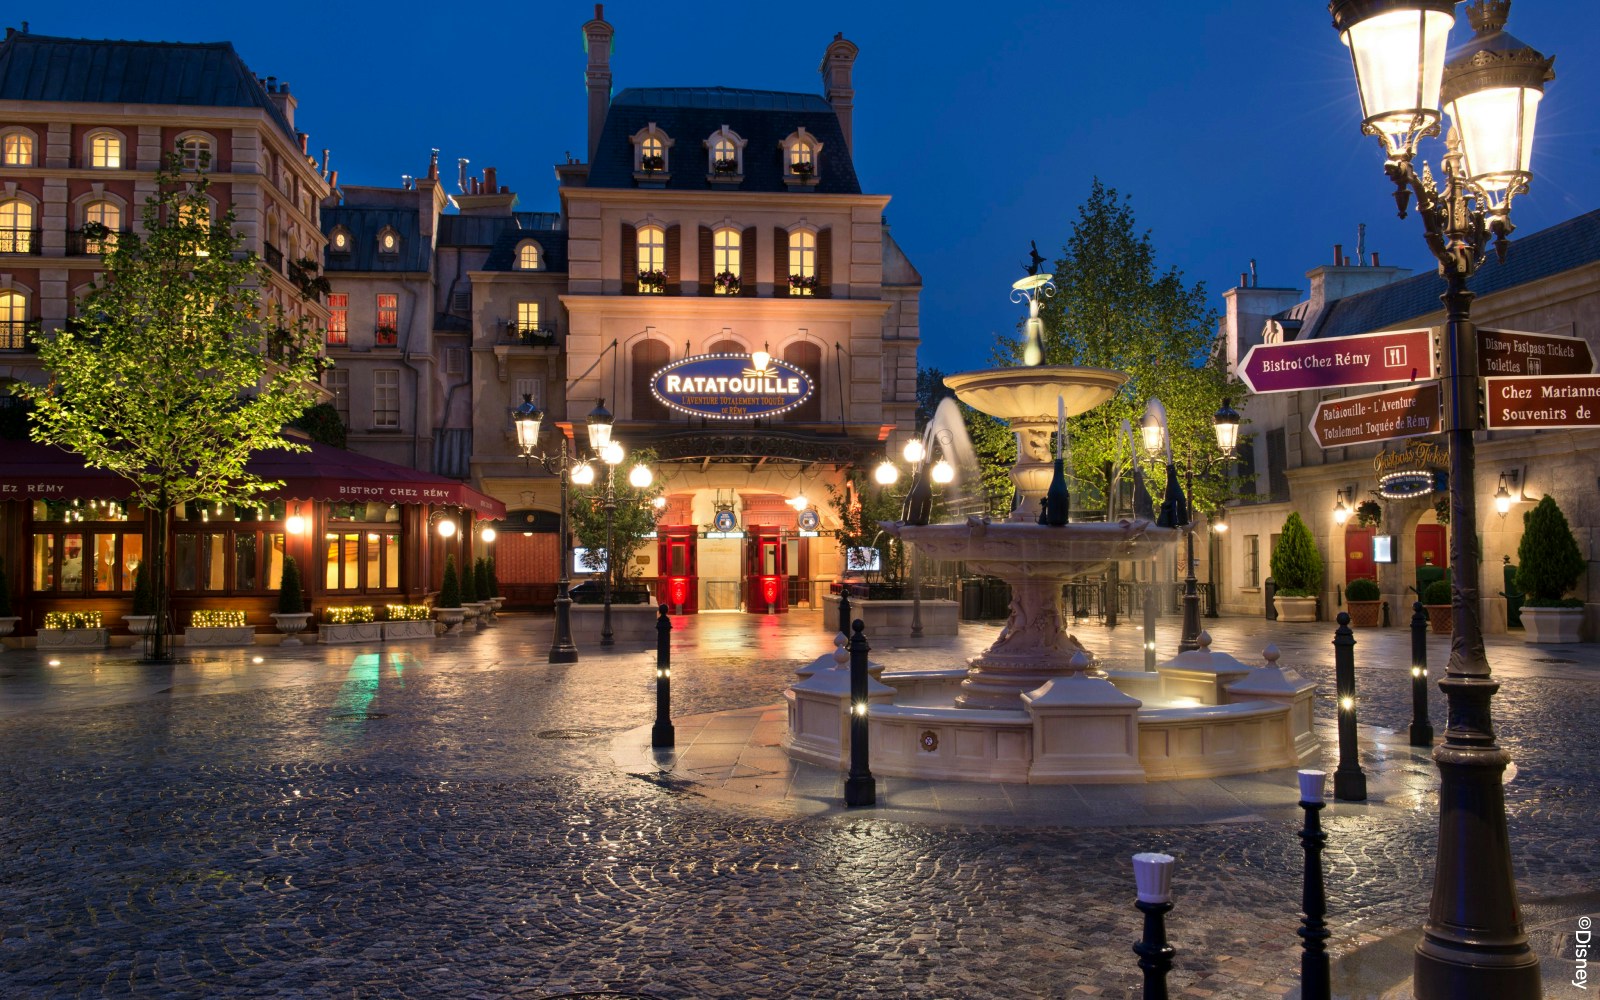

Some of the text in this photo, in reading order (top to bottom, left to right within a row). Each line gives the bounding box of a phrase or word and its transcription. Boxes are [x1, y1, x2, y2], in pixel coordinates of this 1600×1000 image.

[1485, 338, 1575, 358] Disney Fastpass Tickets
[1262, 352, 1371, 373] Bistrot Chez Rémy
[1486, 358, 1521, 373] Toilettes
[666, 375, 800, 394] RATATOUILLE
[1501, 385, 1600, 399] Chez Marianne
[682, 395, 785, 406] L'AVENTURE TOTALEMENT TOQUÉE
[729, 406, 747, 415] RÉMY
[1323, 403, 1366, 421] Ratatouille
[1373, 396, 1417, 413] L'Aventure
[1502, 405, 1591, 421] Souvenirs de
[1324, 414, 1430, 440] Totalement Toquée de Rémy
[27, 482, 64, 492] RÉMY
[339, 486, 450, 498] BISTROT CHEZ RÉMY
